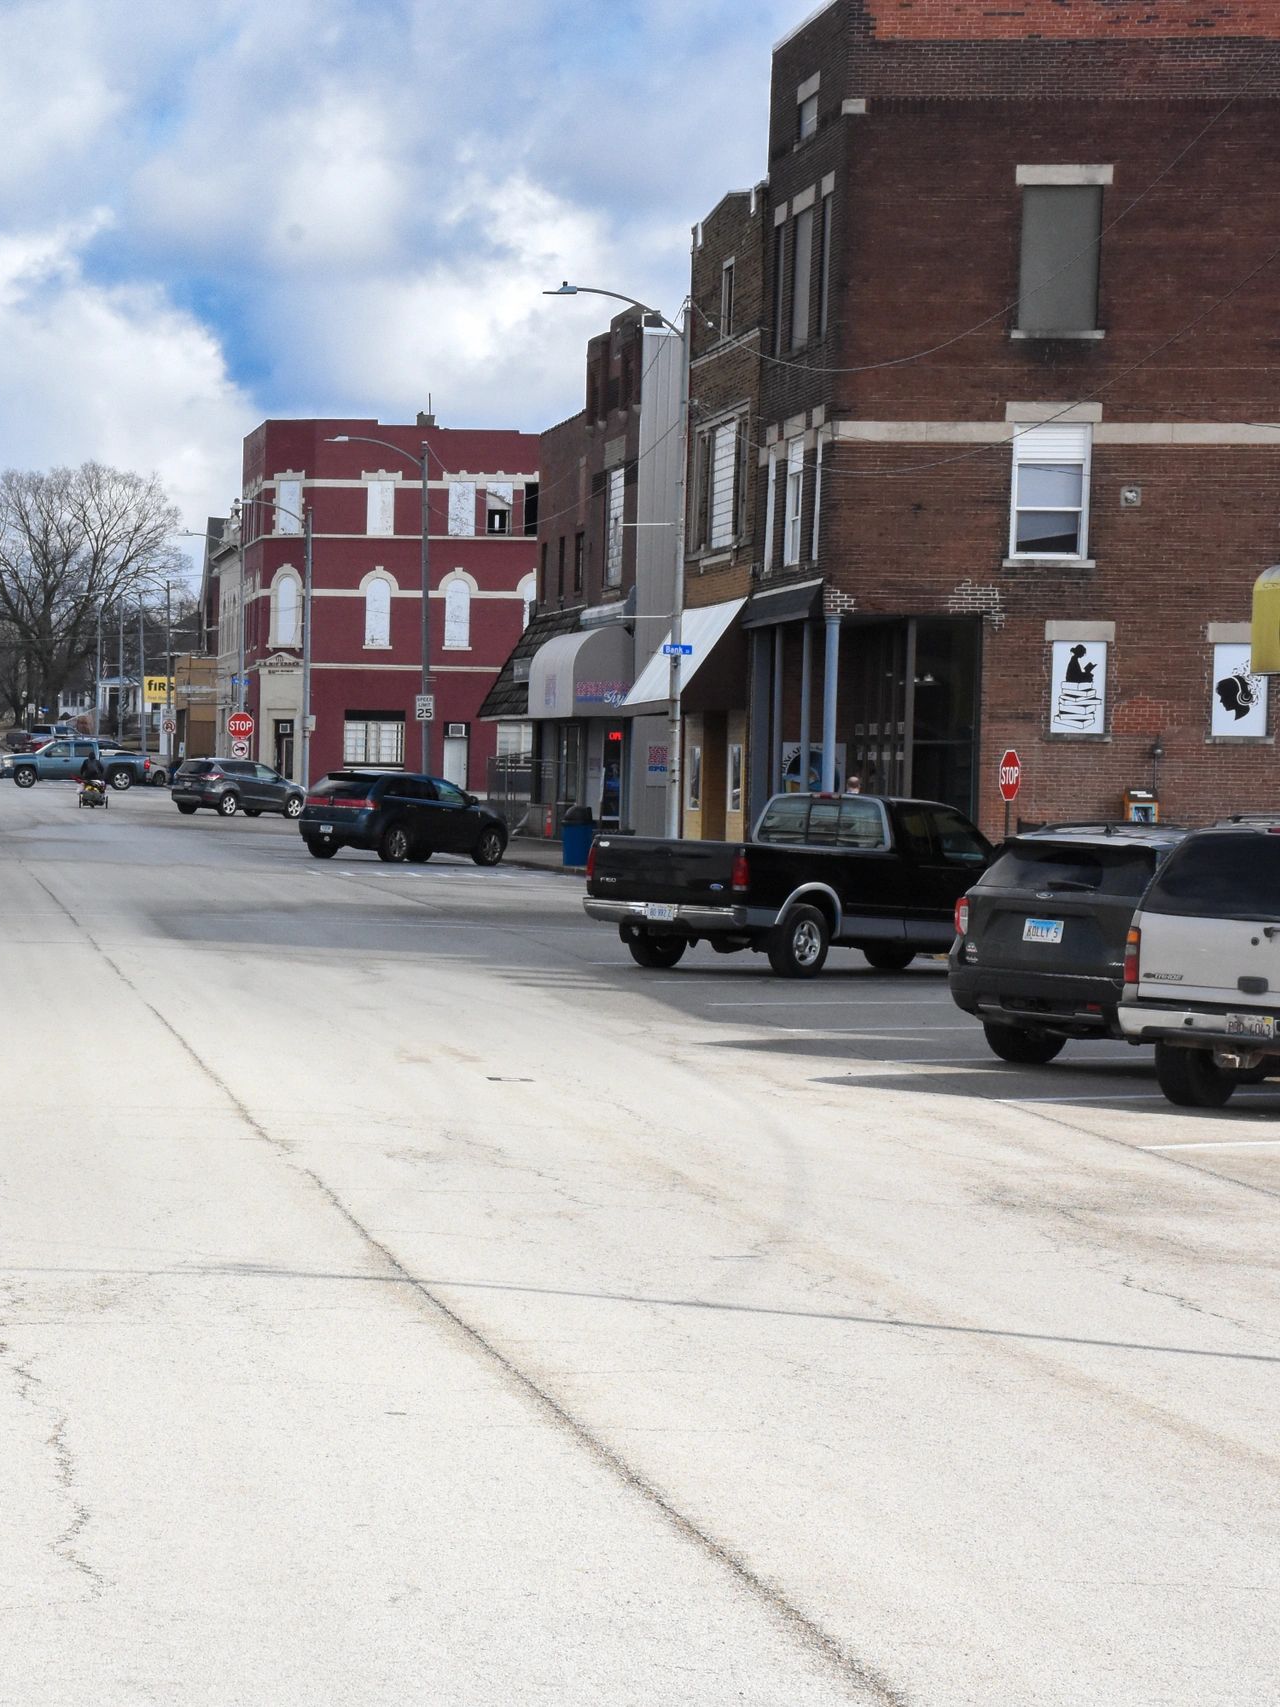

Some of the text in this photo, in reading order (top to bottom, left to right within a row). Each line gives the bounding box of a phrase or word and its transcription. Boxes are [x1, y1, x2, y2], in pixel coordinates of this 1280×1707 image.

[417, 708, 433, 719] 25
[229, 720, 253, 732] STOP
[1000, 766, 1019, 785] STOP
